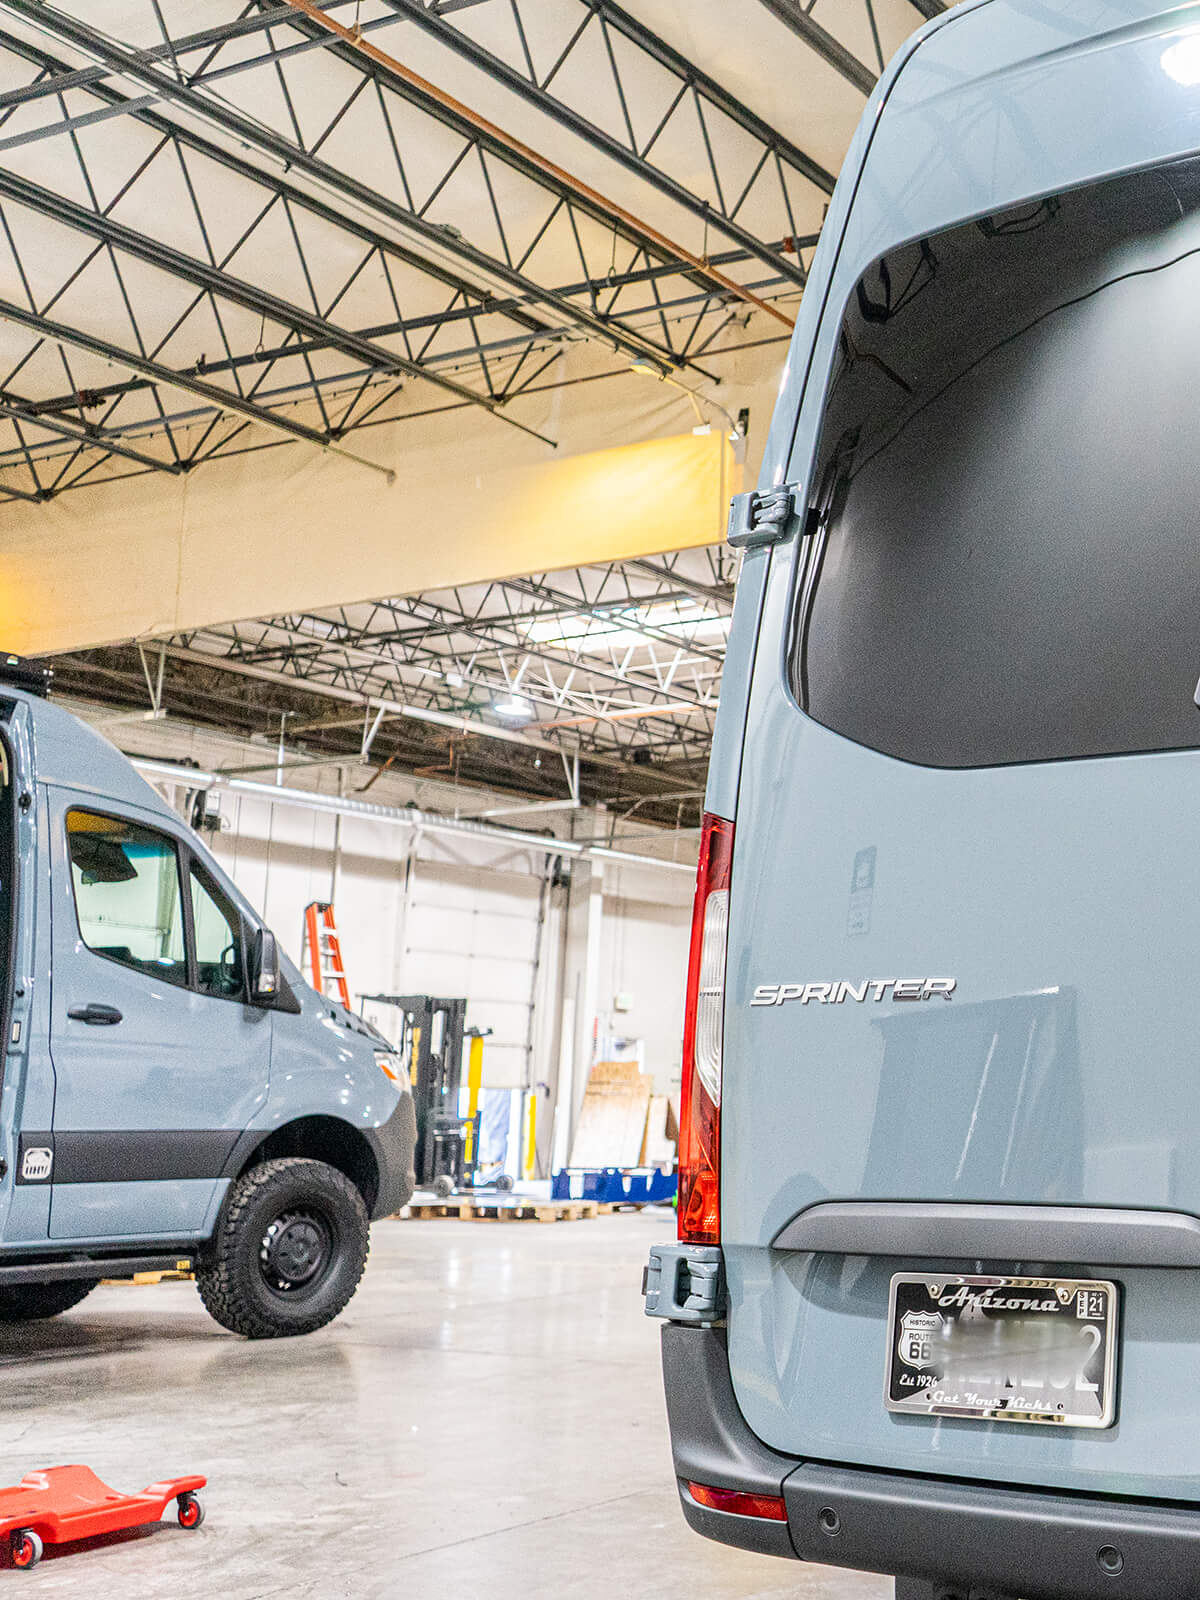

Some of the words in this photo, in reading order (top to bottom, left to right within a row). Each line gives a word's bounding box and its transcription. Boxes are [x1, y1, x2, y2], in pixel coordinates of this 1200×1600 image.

[750, 977, 957, 1007] SPRINTER
[937, 1286, 1060, 1312] Arizona
[1088, 1296, 1103, 1312] 21
[909, 1319, 936, 1327] HISTORIC
[908, 1341, 932, 1360] 66
[916, 1374, 938, 1388] 1926
[932, 1390, 960, 1405] Get
[964, 1392, 1004, 1410] Your
[1006, 1395, 1053, 1411] Kicks
